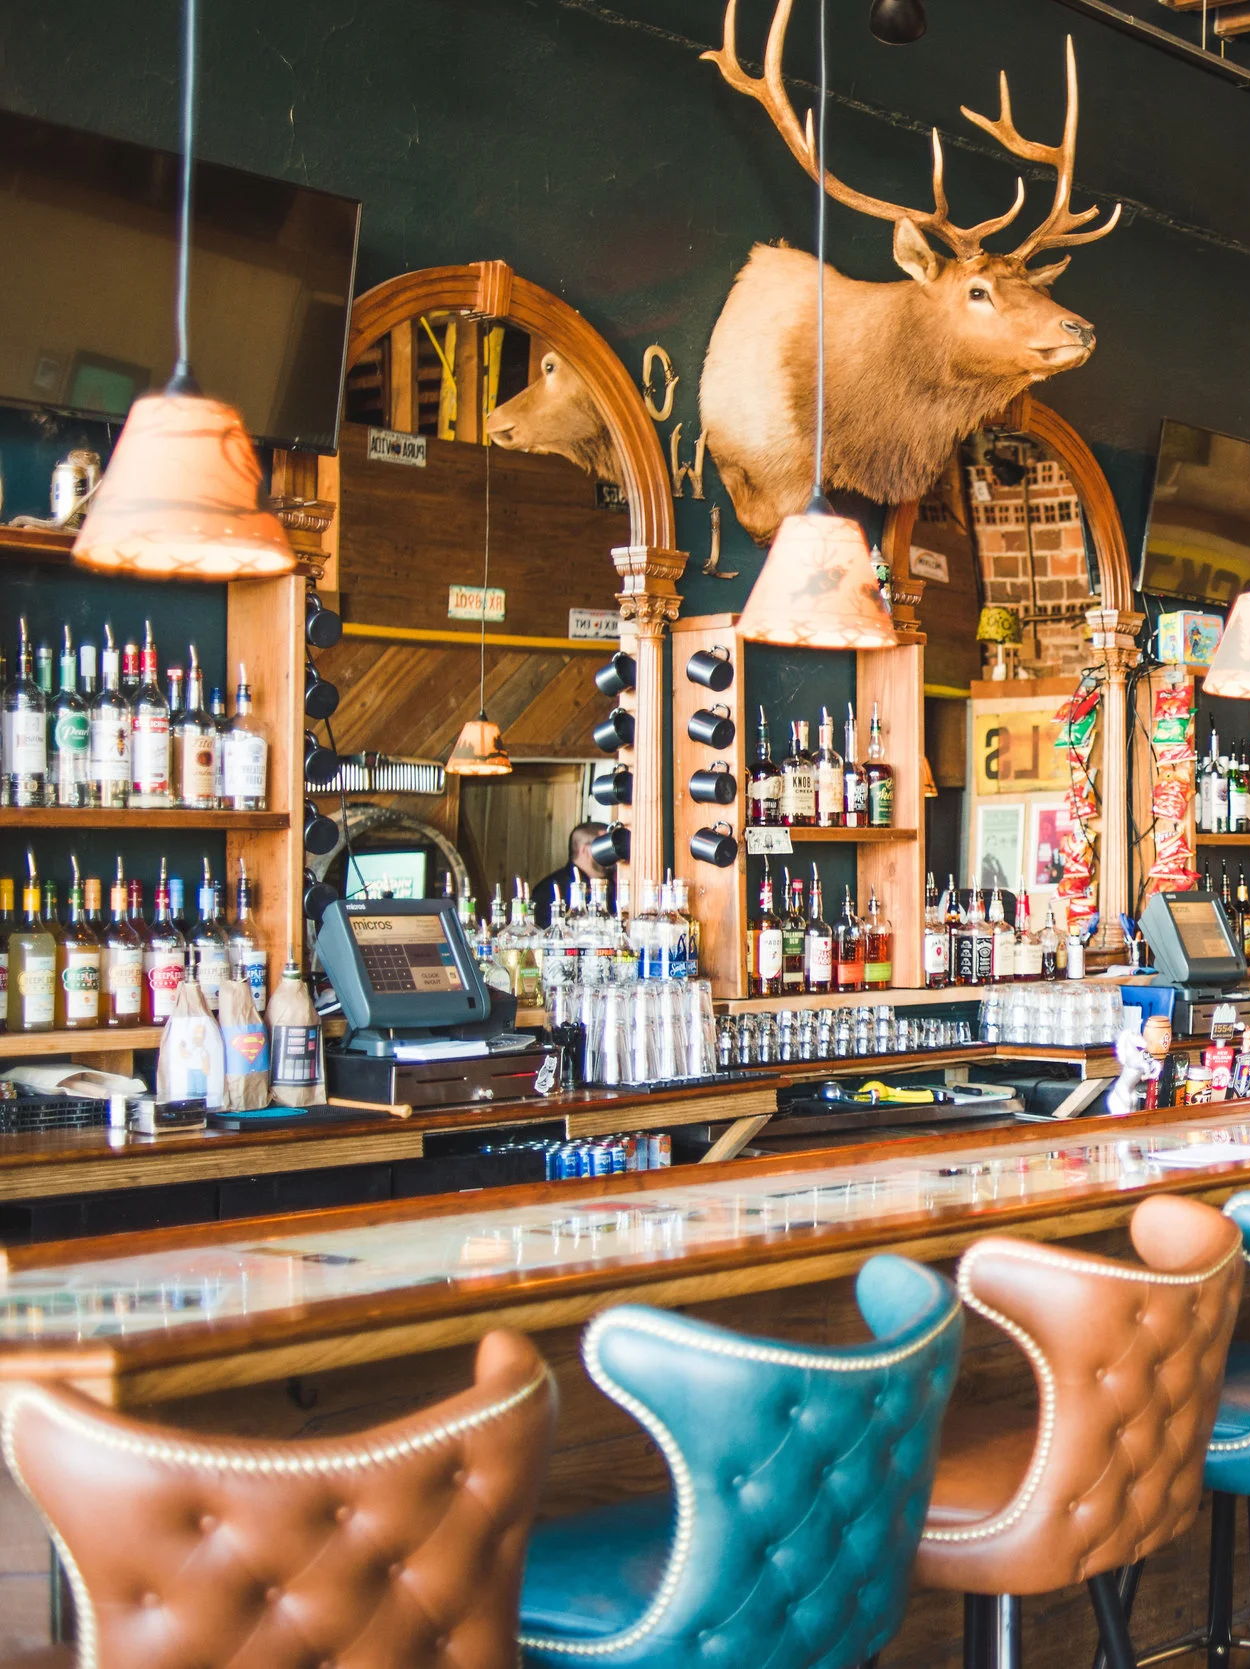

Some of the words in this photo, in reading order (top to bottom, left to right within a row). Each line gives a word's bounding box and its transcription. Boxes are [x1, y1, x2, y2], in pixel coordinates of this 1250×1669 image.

[62, 725, 90, 740] Pearl
[792, 776, 811, 788] KNOB
[345, 903, 366, 911] micros
[353, 918, 393, 931] micros
[1213, 1024, 1233, 1033] 1554
